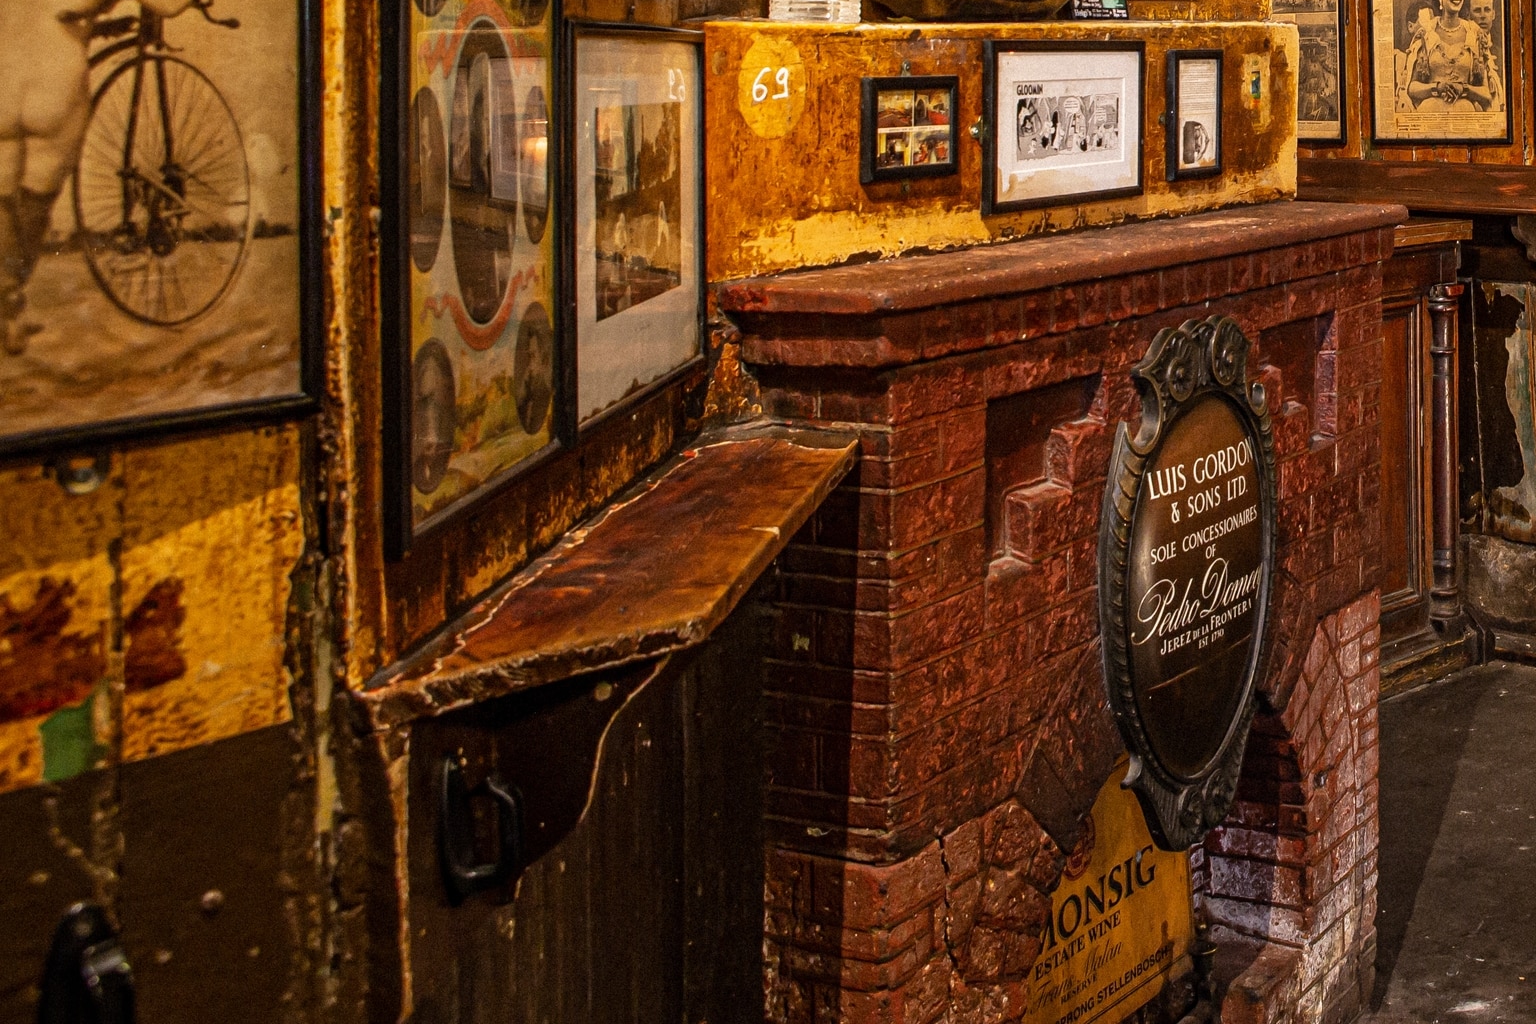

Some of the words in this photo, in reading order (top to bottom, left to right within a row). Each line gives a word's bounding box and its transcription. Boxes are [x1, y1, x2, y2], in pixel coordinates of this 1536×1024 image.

[752, 66, 790, 102] 69
[1147, 464, 1187, 500] LUIS
[1193, 436, 1254, 484] GORDON
[1171, 502, 1180, 524] &
[1187, 485, 1221, 518] SONS
[1227, 475, 1248, 507] LTD.
[1150, 541, 1177, 565] SOLE
[1182, 504, 1258, 552] CONCESSIONAIRES
[1205, 544, 1216, 559] OF
[1131, 578, 1201, 645] Pedro
[1160, 630, 1192, 655] JEREZ
[1201, 626, 1209, 637] LA
[1198, 636, 1209, 650] EST
[1035, 934, 1086, 982] ESTATE
[1088, 910, 1122, 944] WINE
[1060, 975, 1098, 1006] RESERVE
[1097, 945, 1169, 1002] STELLENBOSCH
